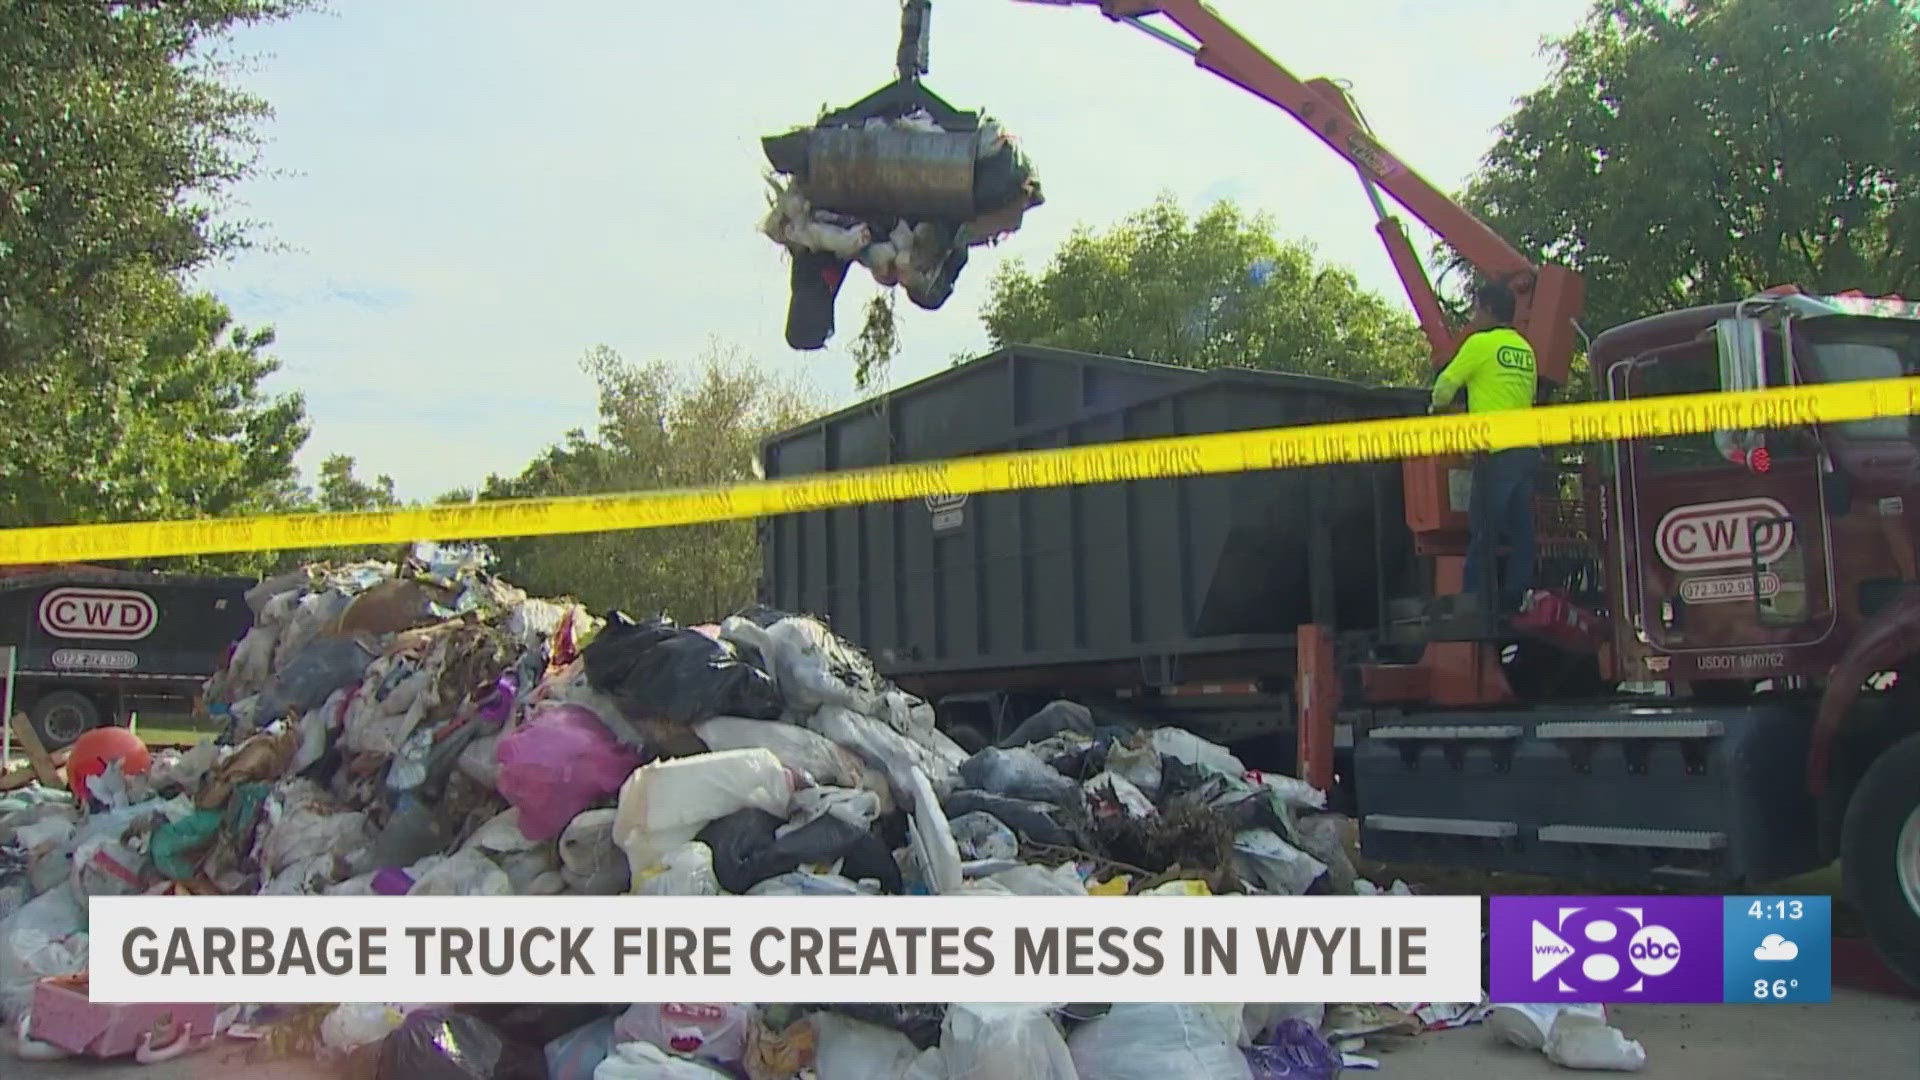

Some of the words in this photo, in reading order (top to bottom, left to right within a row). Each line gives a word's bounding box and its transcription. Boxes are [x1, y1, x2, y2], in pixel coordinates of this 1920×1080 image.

[1570, 414, 1611, 443] FIRE
[1619, 409, 1658, 440] LINE
[1669, 406, 1697, 435] DO
[1703, 402, 1743, 433] NOT
[1751, 396, 1820, 430] CROSS
[1358, 431, 1385, 462] DO
[1389, 429, 1422, 458] NOT
[1430, 422, 1491, 455] CROSS
[1673, 516, 1774, 554] CWD
[54, 601, 143, 628] CWD
